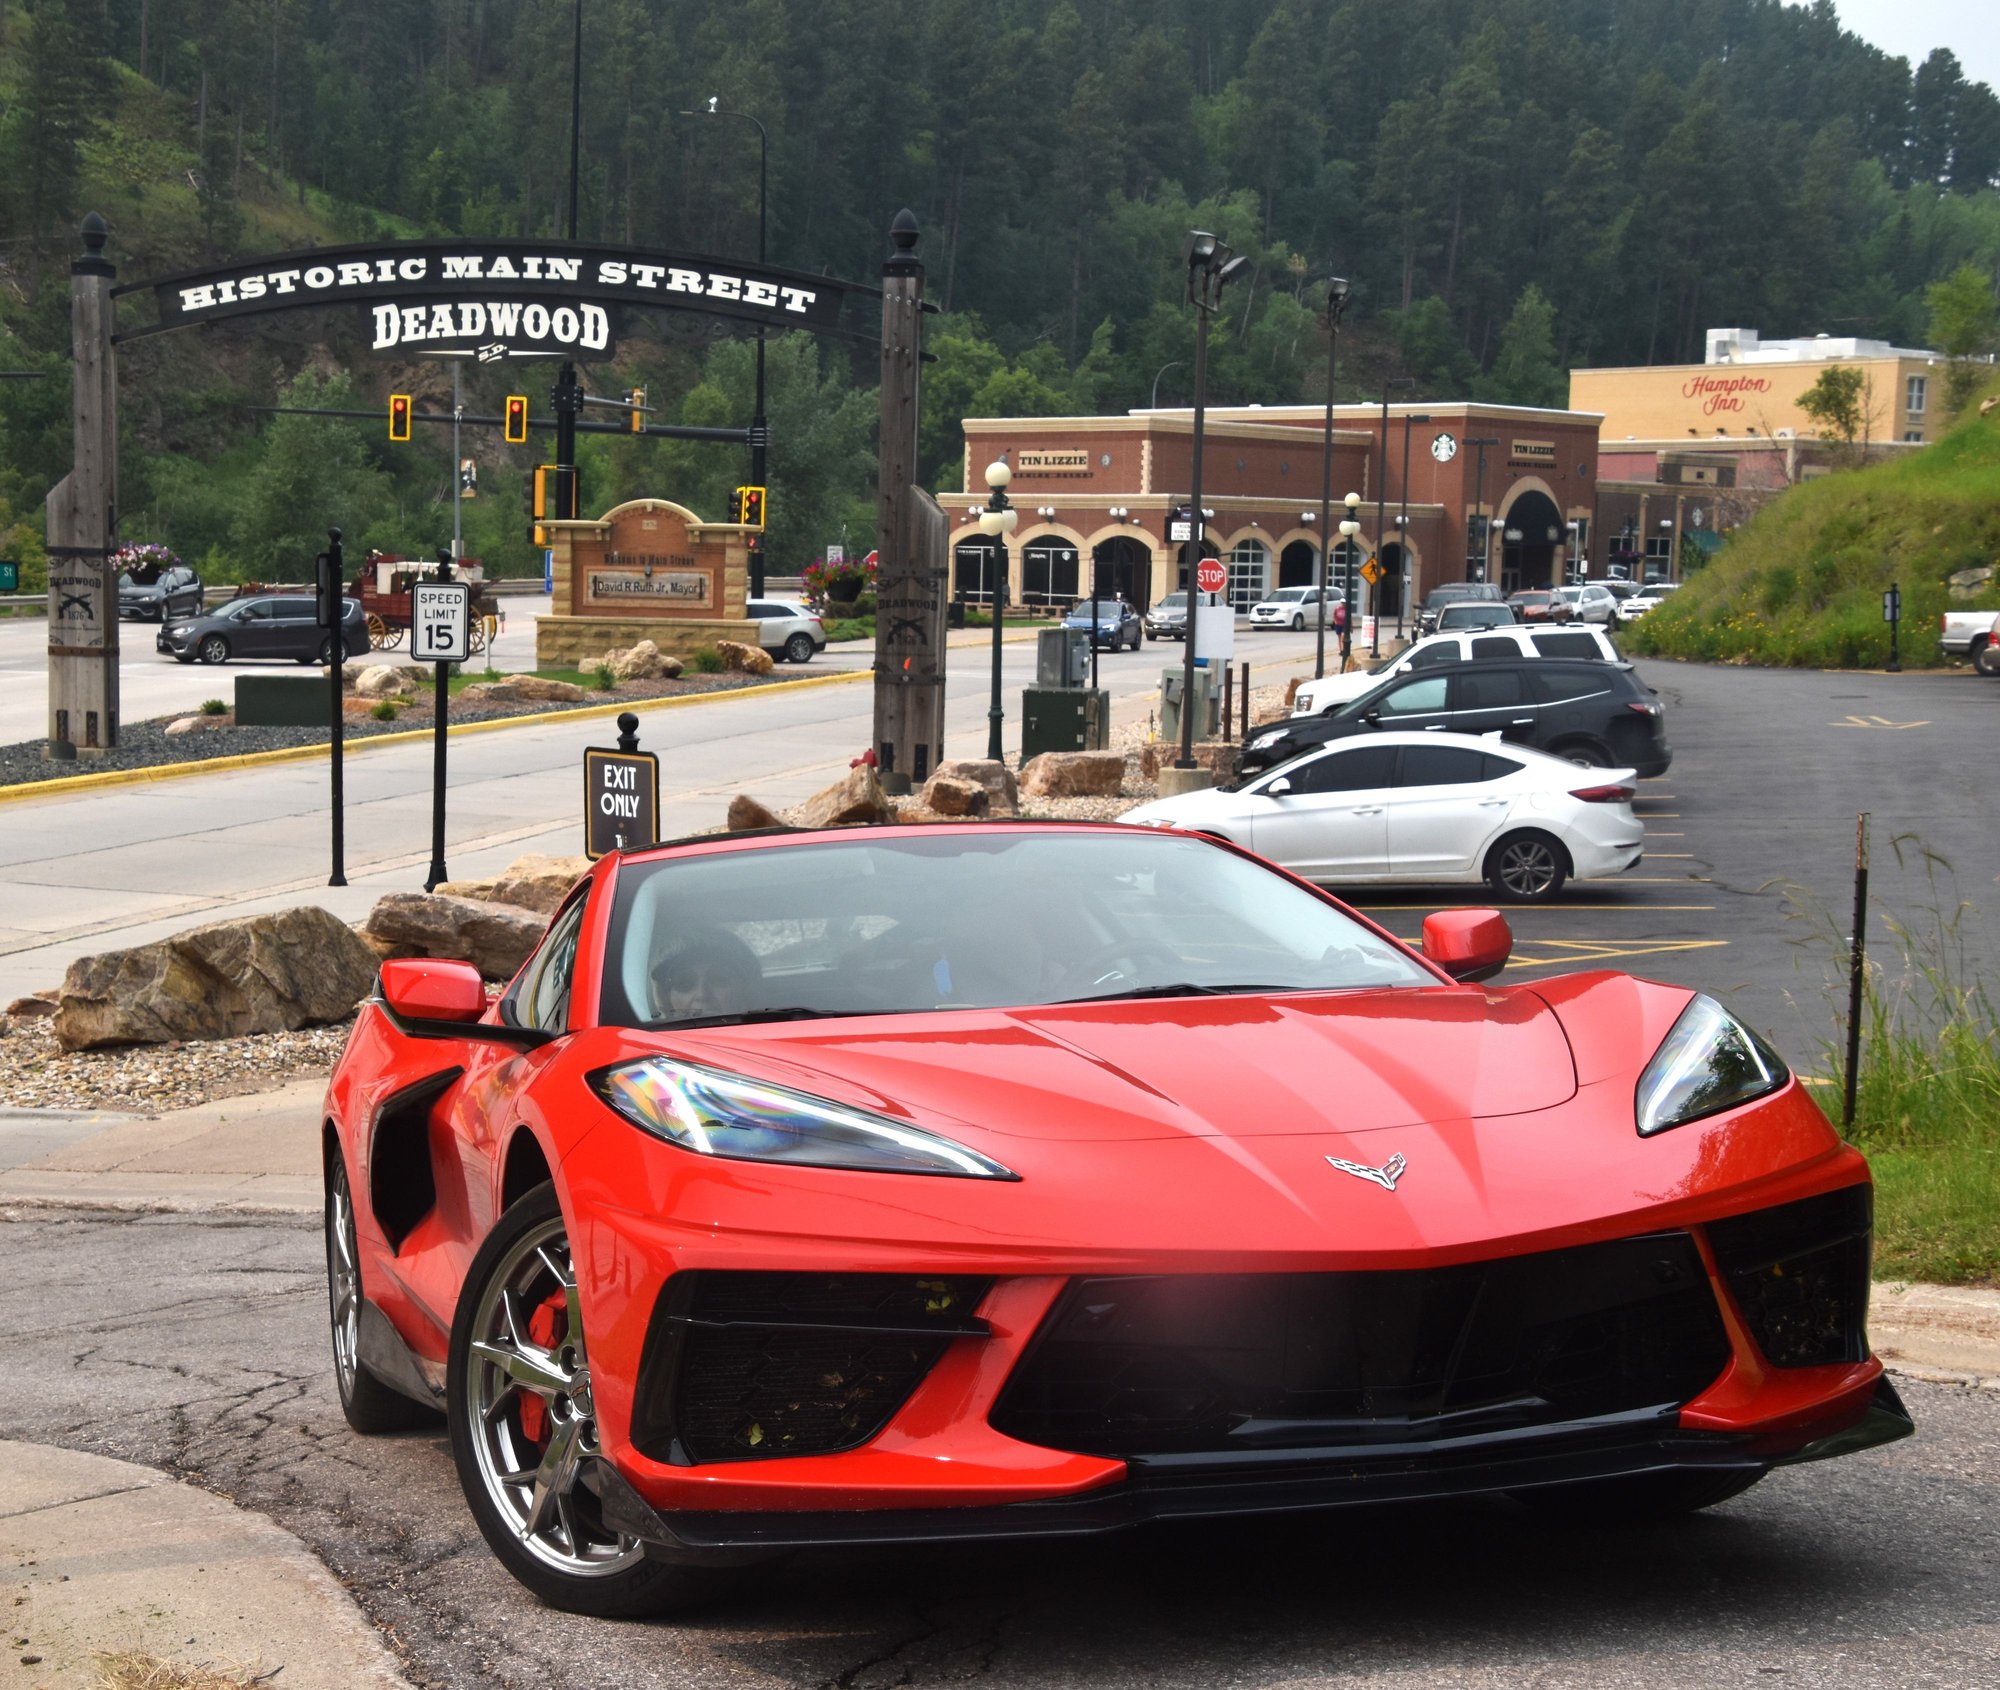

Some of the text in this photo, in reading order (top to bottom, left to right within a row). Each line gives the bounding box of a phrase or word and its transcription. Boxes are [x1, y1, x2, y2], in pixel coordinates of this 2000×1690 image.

[179, 256, 816, 313] HISTORIC MAIN STREET
[372, 303, 610, 350] DEADWOOD
[1682, 376, 1772, 399] Hampton
[1703, 394, 1746, 416] Inn
[1020, 456, 1087, 465] TIN LIZZIE
[3, 566, 13, 577] St
[1197, 569, 1224, 583] STOP
[49, 577, 102, 589] DEADWOOD
[597, 581, 623, 592] David
[625, 581, 632, 592] R
[633, 581, 654, 592] Ruth
[670, 583, 698, 595] Mayor
[420, 593, 463, 604] SPEED
[878, 599, 937, 611] DEADWOOD
[424, 609, 457, 620] LIMIT
[425, 624, 454, 651] 15
[603, 764, 637, 790] EXIT
[600, 792, 640, 818] ONLY
